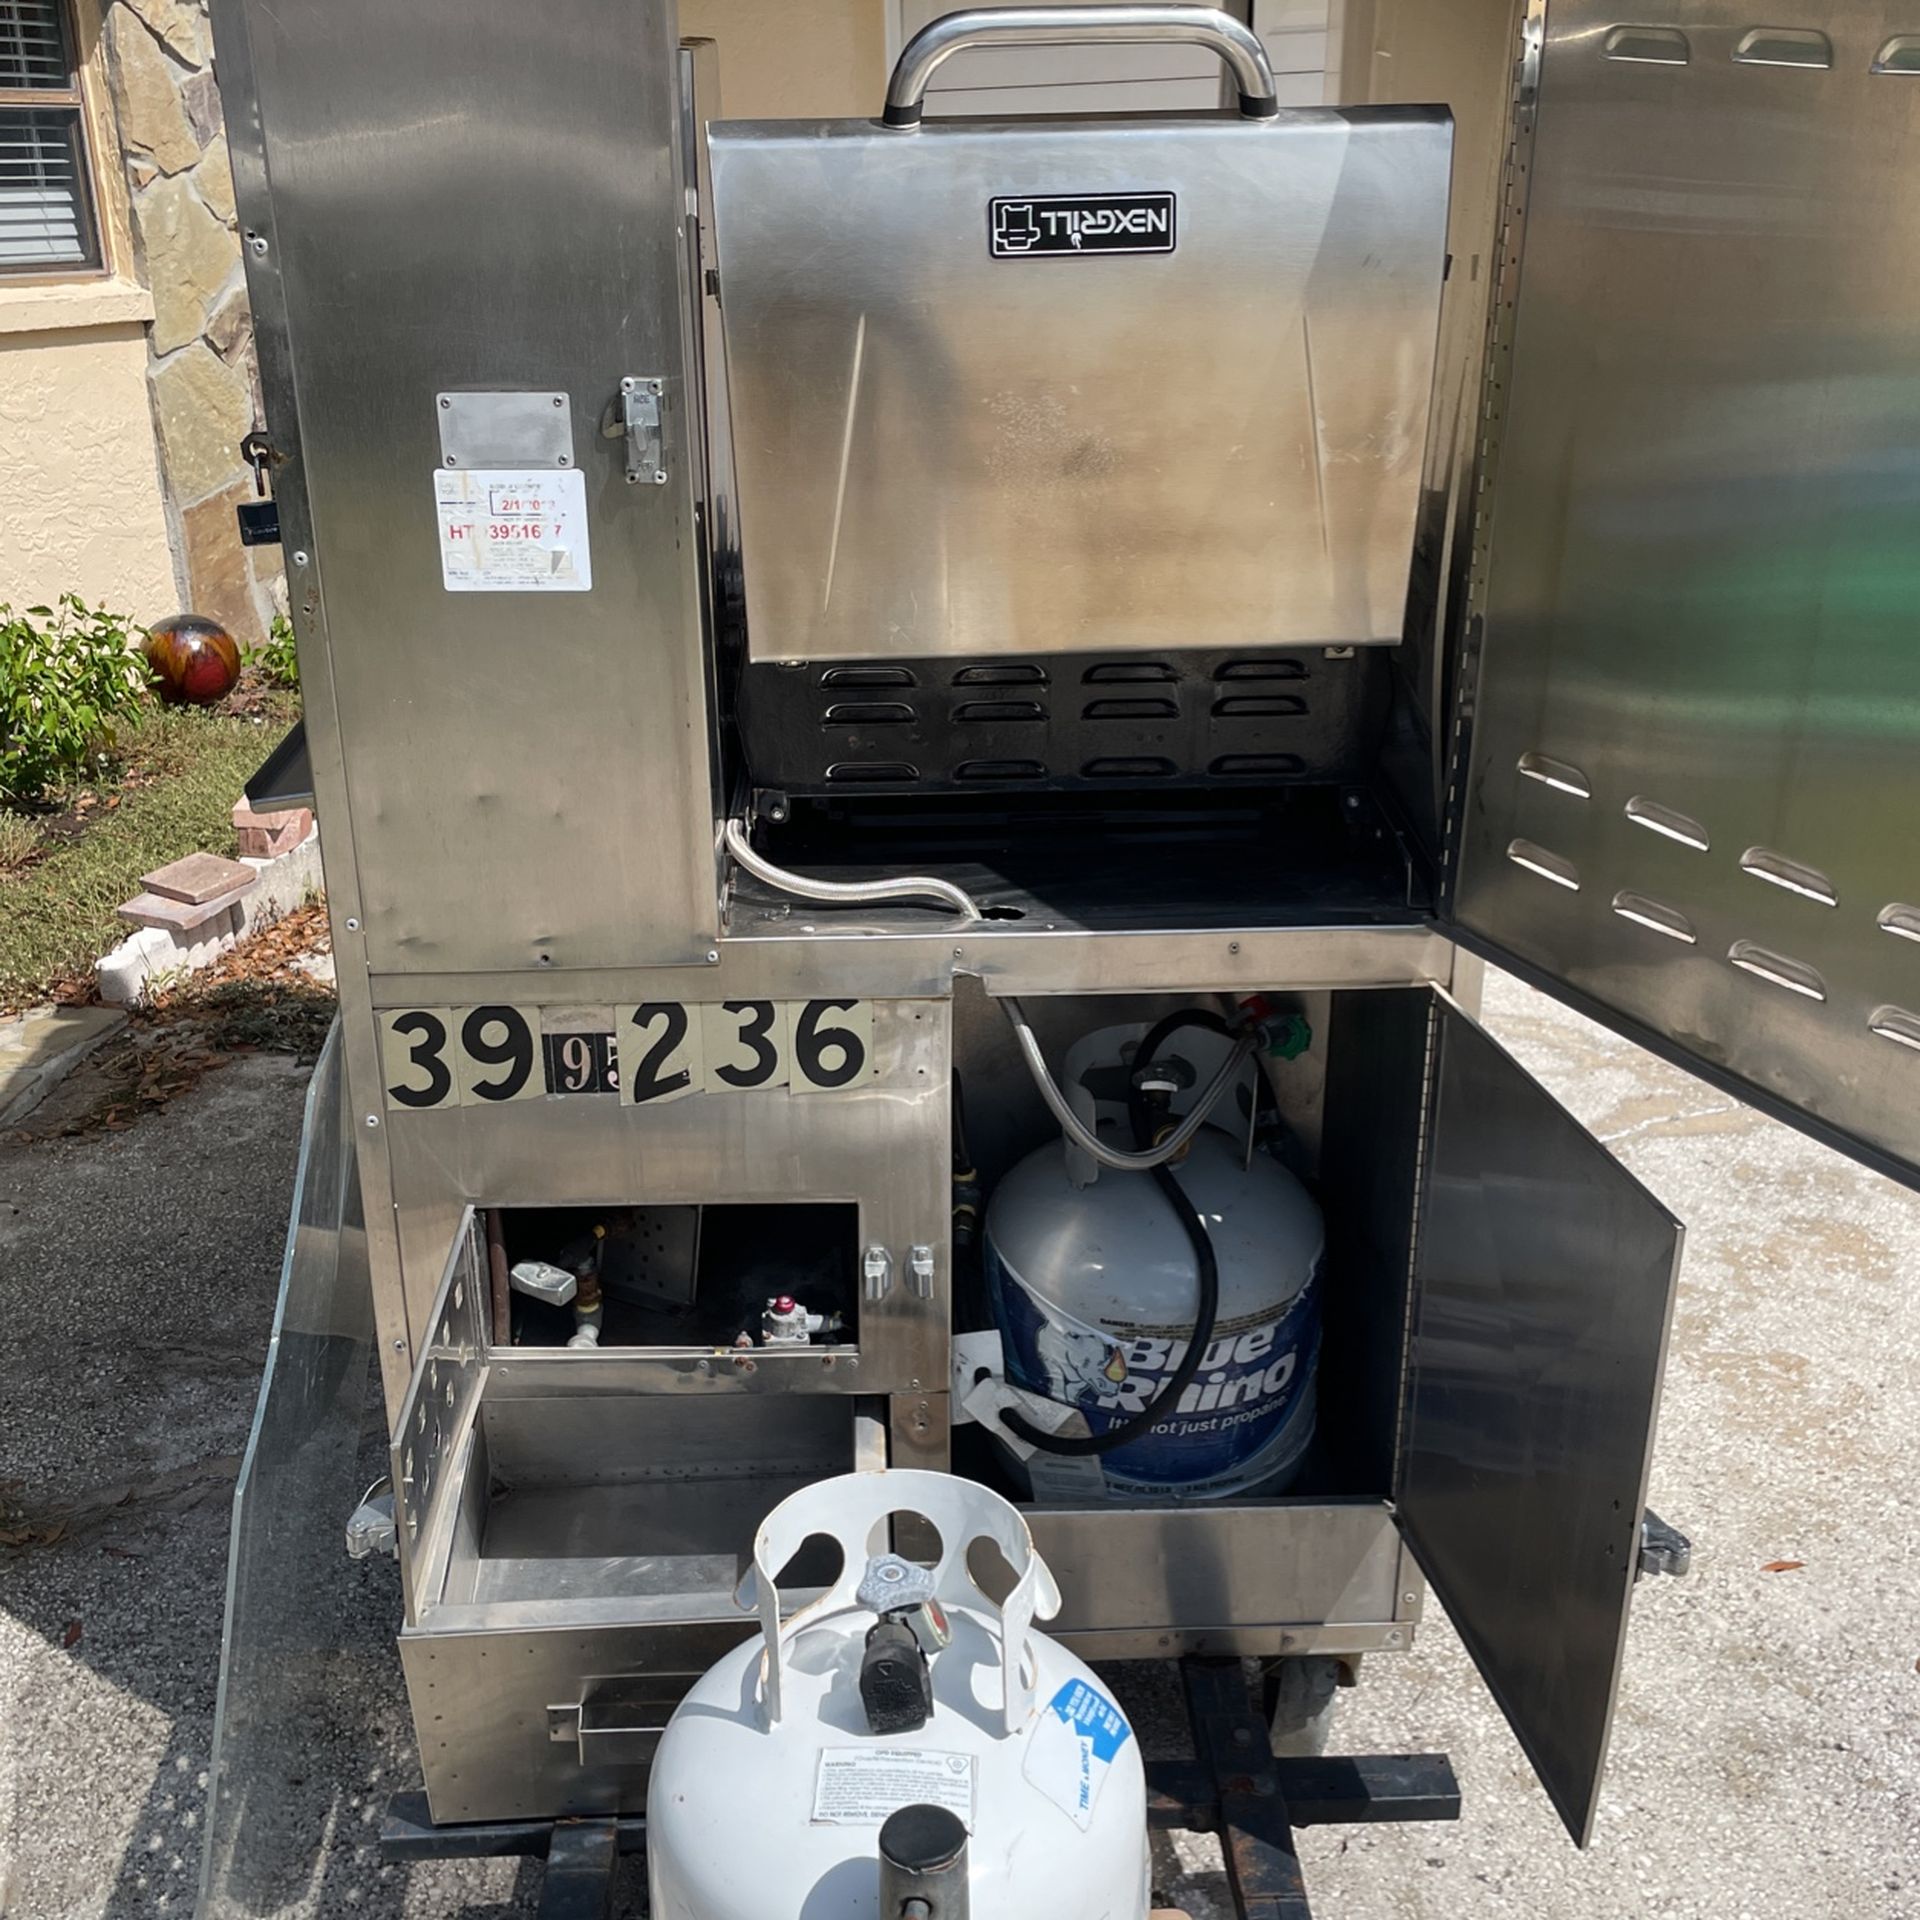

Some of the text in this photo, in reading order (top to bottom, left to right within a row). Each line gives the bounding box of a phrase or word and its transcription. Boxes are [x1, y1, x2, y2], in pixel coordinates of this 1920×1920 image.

[1041, 208, 1168, 248] NEXGRILL
[1126, 1325, 1276, 1372] Blue
[1178, 1417, 1218, 1436] just
[1079, 1780, 1089, 1810] TIME
